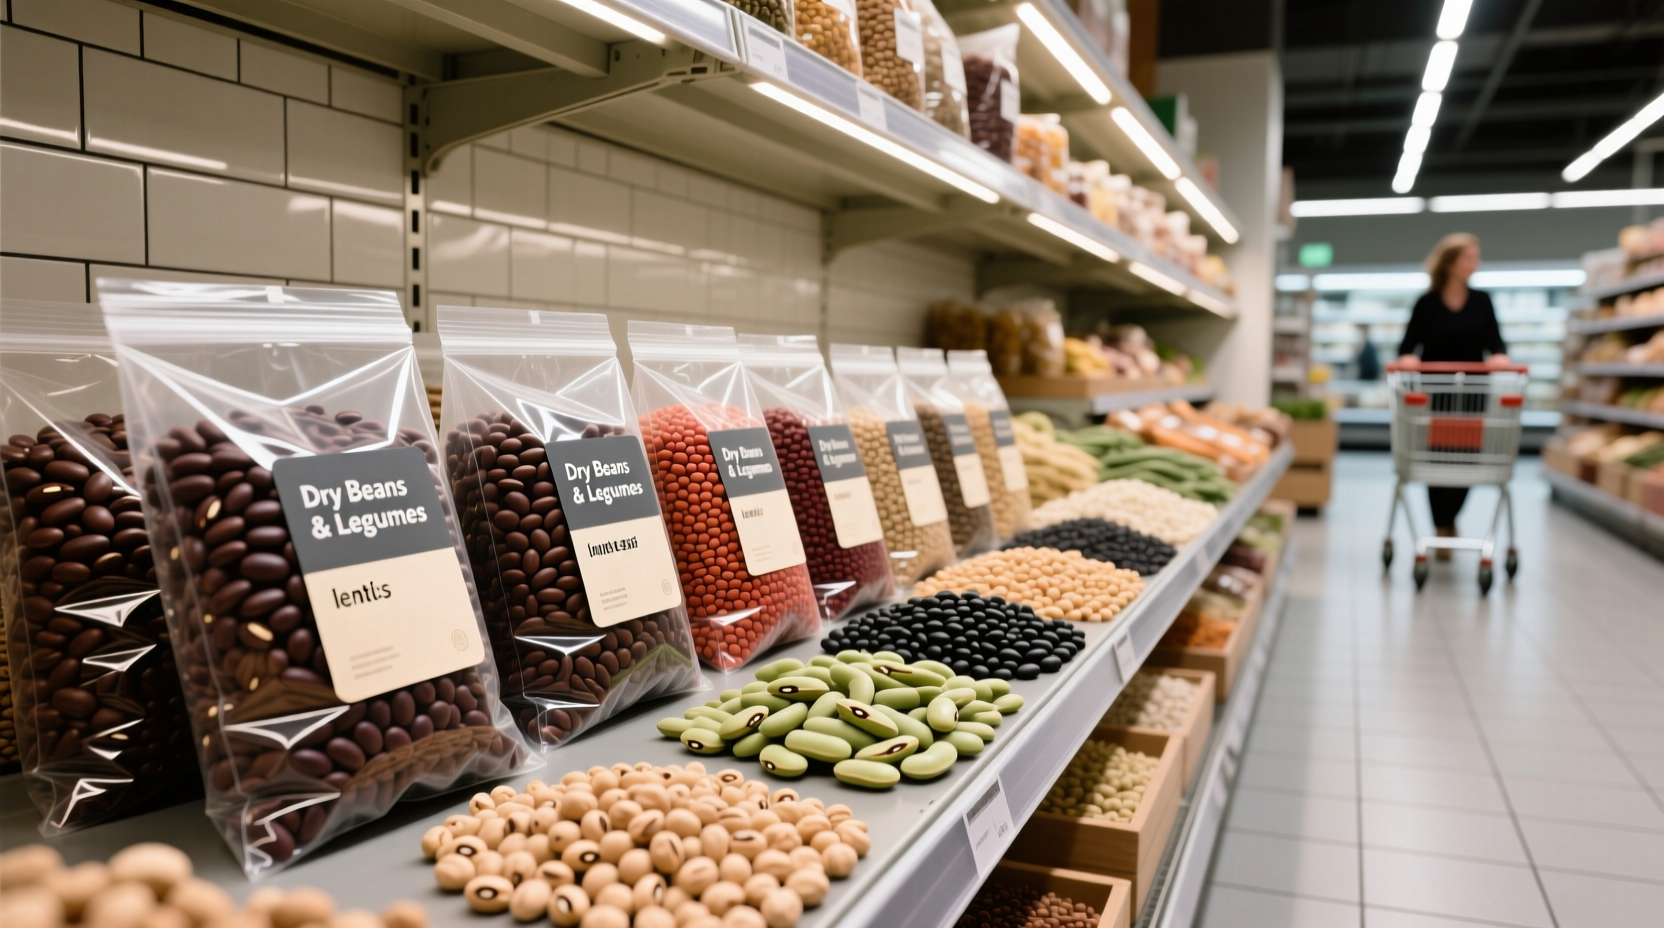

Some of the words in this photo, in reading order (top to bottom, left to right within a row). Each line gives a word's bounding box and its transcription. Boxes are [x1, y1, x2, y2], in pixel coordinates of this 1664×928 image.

[721, 447, 739, 464] Dry
[564, 462, 591, 484] Dry
[592, 460, 630, 477] Beans
[299, 484, 342, 511] Dry
[344, 479, 408, 503] Beans
[572, 486, 585, 504] &
[586, 482, 643, 505] Legumes
[311, 515, 333, 540] &
[334, 506, 428, 538] Legumes
